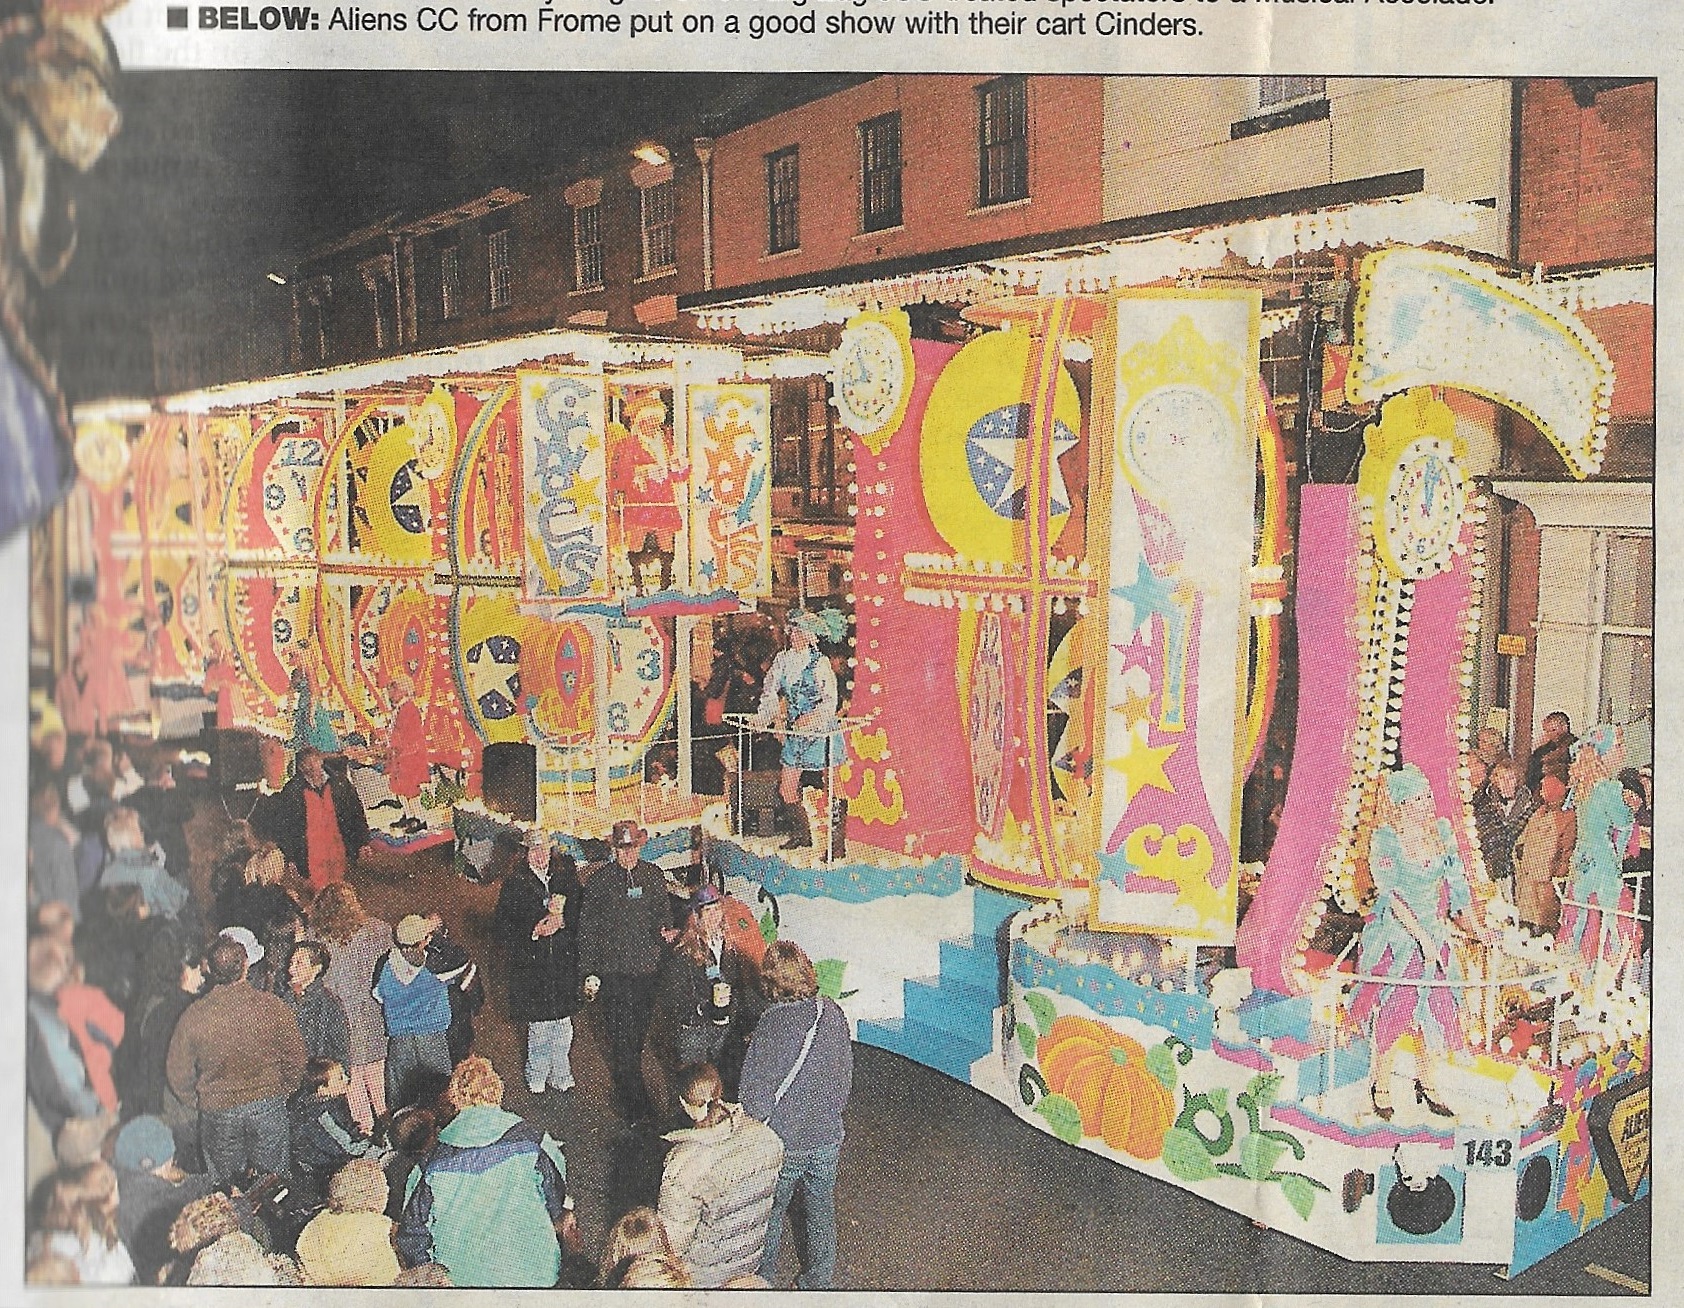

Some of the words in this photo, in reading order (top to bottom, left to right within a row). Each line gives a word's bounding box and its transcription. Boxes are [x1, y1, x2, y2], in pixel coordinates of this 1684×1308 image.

[198, 8, 320, 31] BELOW:
[328, 7, 408, 32] Aliens
[416, 8, 459, 32] CC
[467, 9, 527, 32] from
[538, 8, 621, 33] Frome
[630, 11, 674, 39] put
[682, 14, 714, 34] on
[724, 14, 741, 34] a
[749, 10, 816, 40] good
[825, 10, 896, 35] show
[904, 11, 959, 35] with
[968, 11, 1028, 35] their
[1036, 12, 1087, 36] cart
[1095, 11, 1203, 37] Cinders.
[281, 439, 324, 467] 12
[264, 483, 287, 511] 9
[293, 527, 315, 553] 6
[273, 618, 292, 643] 9
[360, 630, 380, 660] 9
[636, 648, 660, 681] 3
[1463, 1139, 1513, 1167] 143
